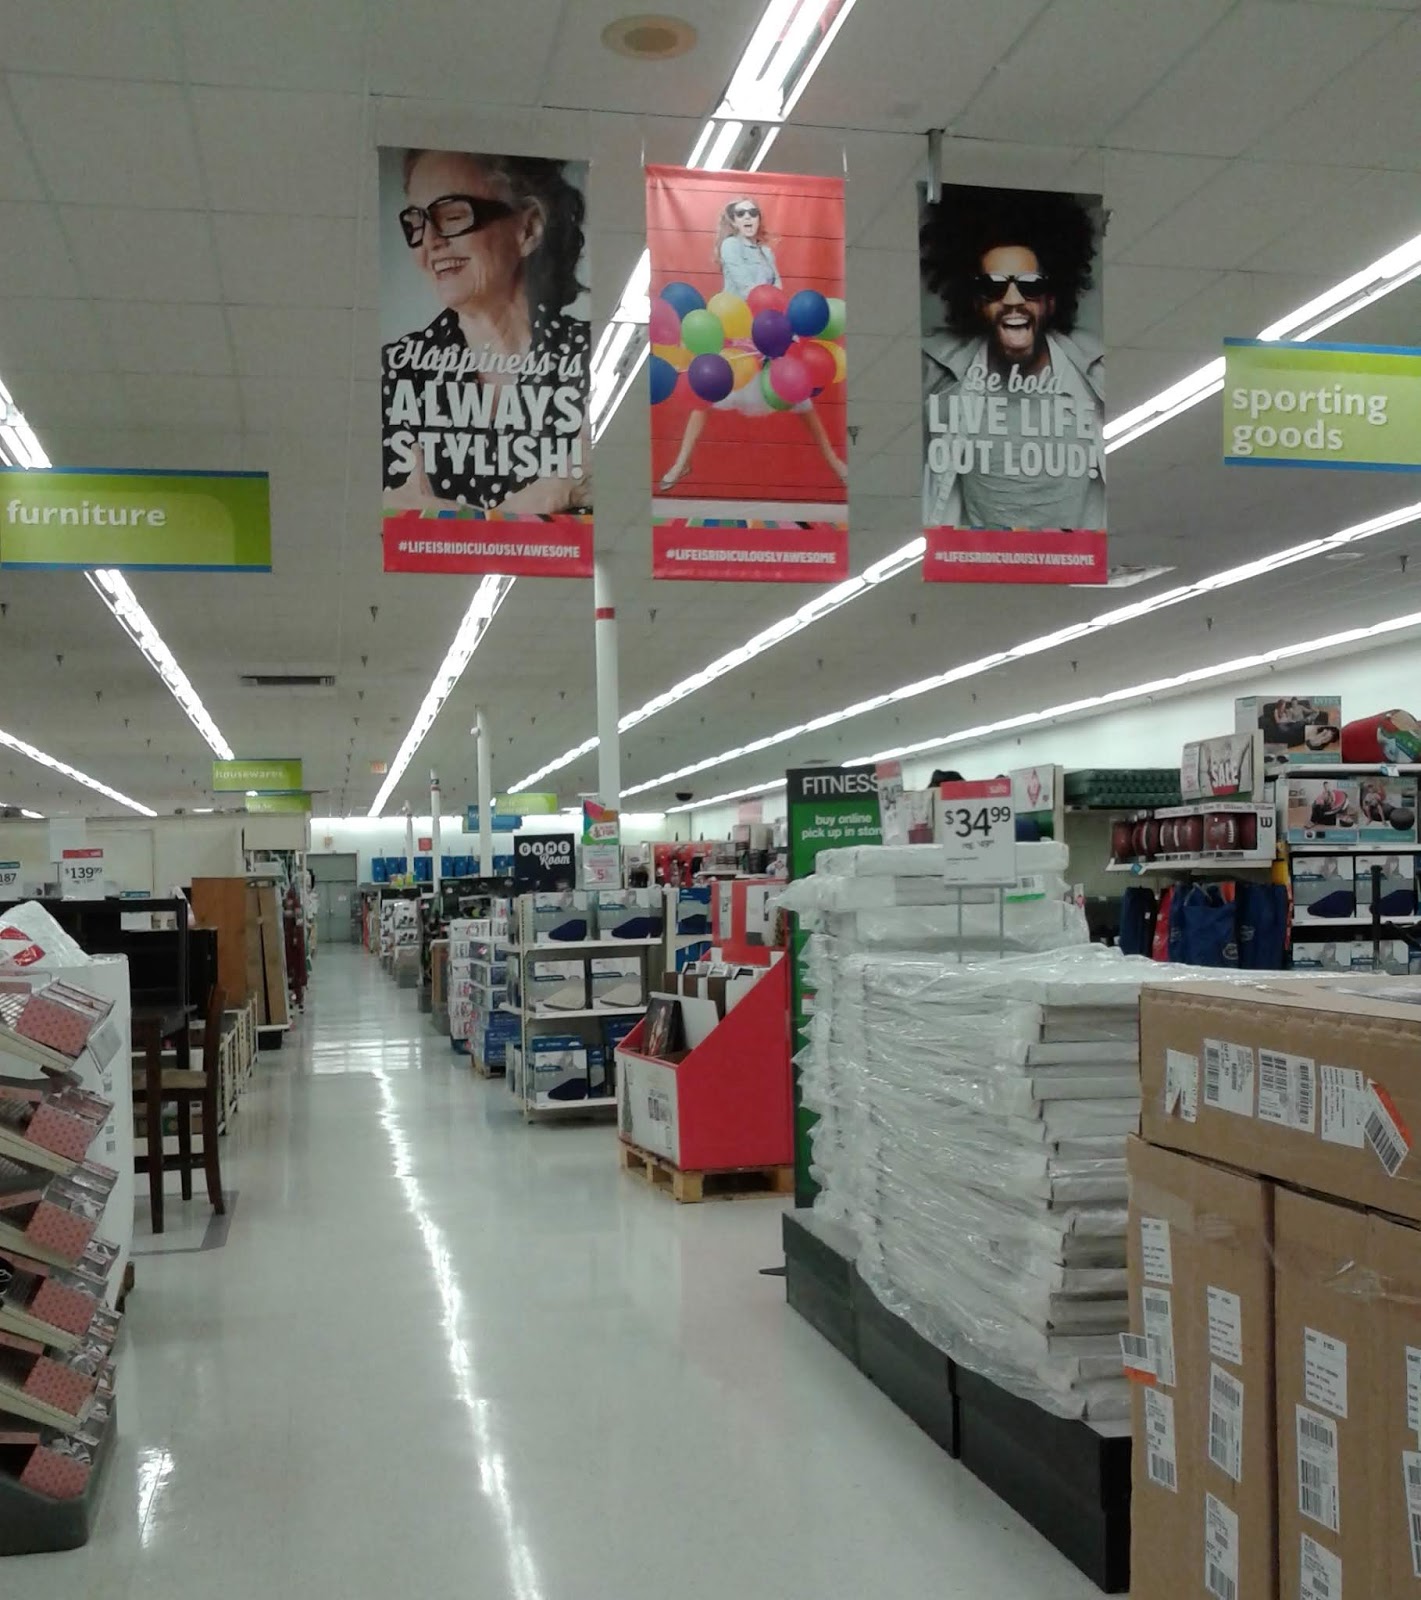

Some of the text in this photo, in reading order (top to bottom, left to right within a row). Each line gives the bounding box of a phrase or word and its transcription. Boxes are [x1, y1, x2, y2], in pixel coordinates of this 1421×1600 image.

[388, 340, 584, 381] Happiness is
[964, 363, 1068, 394] Be bold
[389, 379, 583, 432] ALWAYS
[929, 394, 1096, 440] LIVE LIFE
[1231, 384, 1388, 425] sporting
[1231, 418, 1343, 455] goods
[389, 430, 584, 479] STYLISH!
[928, 438, 1099, 479] OUT LOUD!
[6, 500, 167, 527] furniture
[398, 541, 581, 558] #LIFEISRIDICULOUSLYAWESOME
[665, 548, 837, 564] #LIFEISRIDICULOUSLYAWESOME
[801, 825, 881, 840] pick up in stor
[814, 812, 872, 827] buy online
[519, 841, 570, 856] GAME
[540, 853, 570, 870] Room
